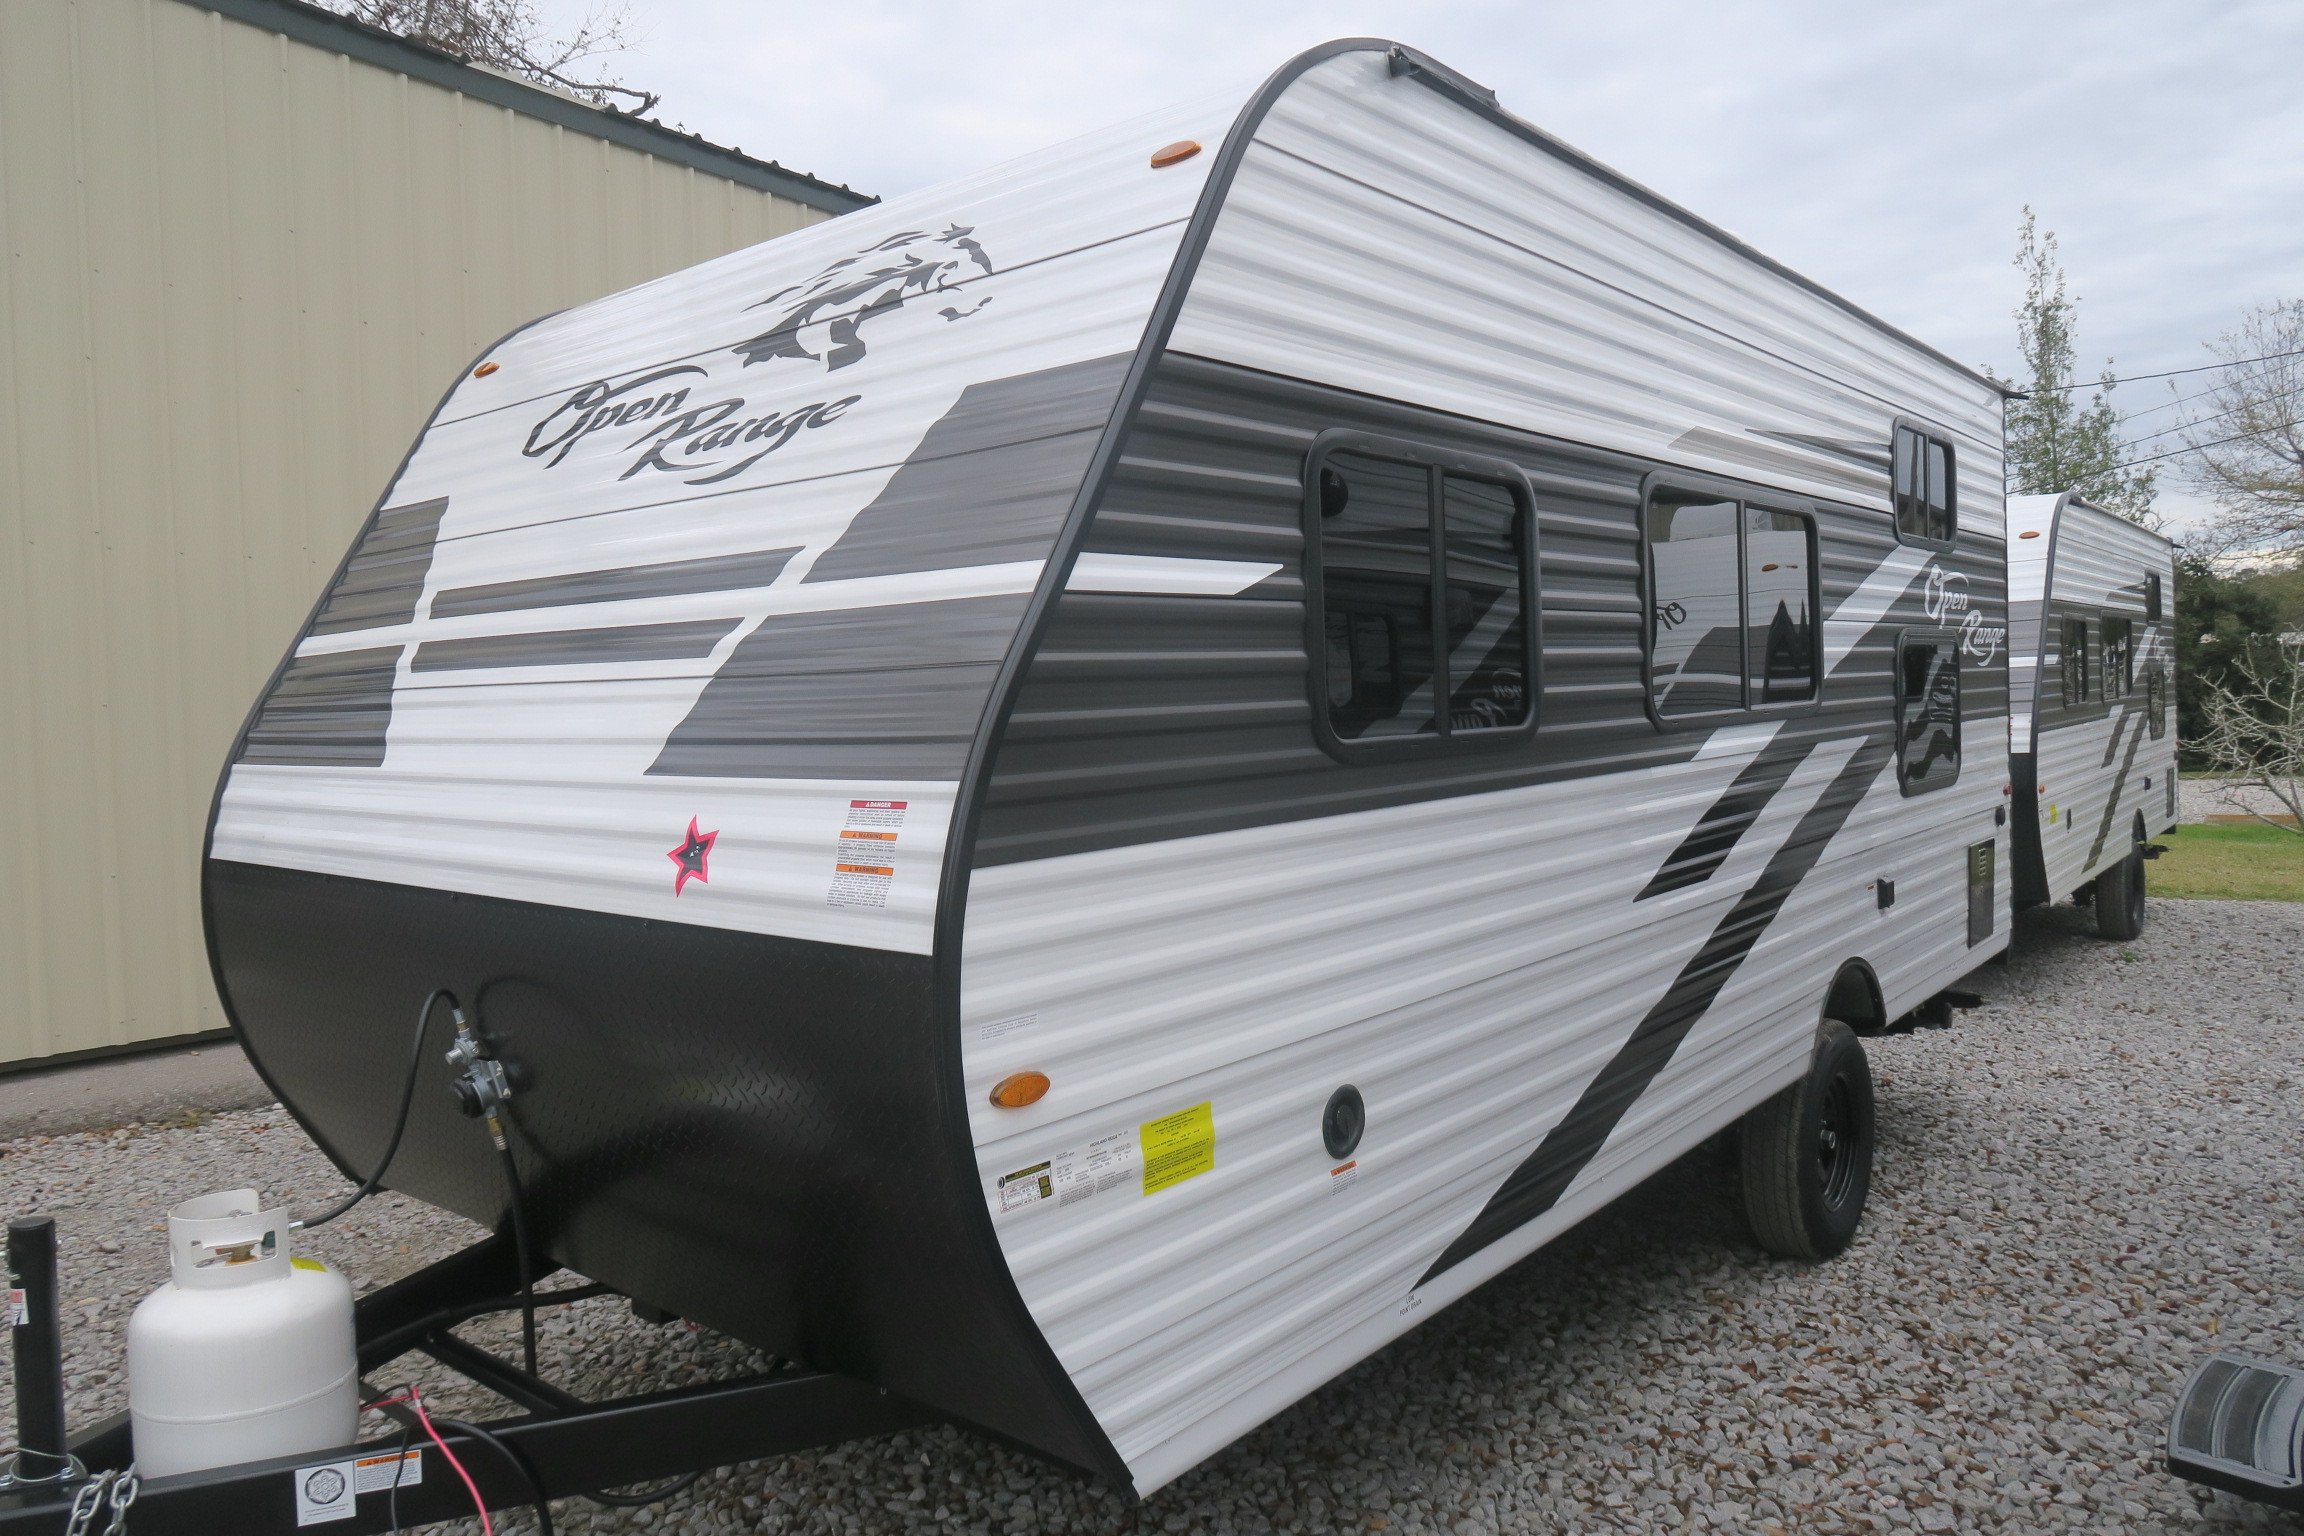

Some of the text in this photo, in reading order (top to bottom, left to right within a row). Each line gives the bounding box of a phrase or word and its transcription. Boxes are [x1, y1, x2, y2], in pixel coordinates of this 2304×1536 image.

[522, 365, 708, 469] Open
[618, 394, 862, 485] Range
[1924, 563, 1969, 629] Open
[1958, 609, 2006, 667] Range
[854, 866, 879, 874] WARNING
